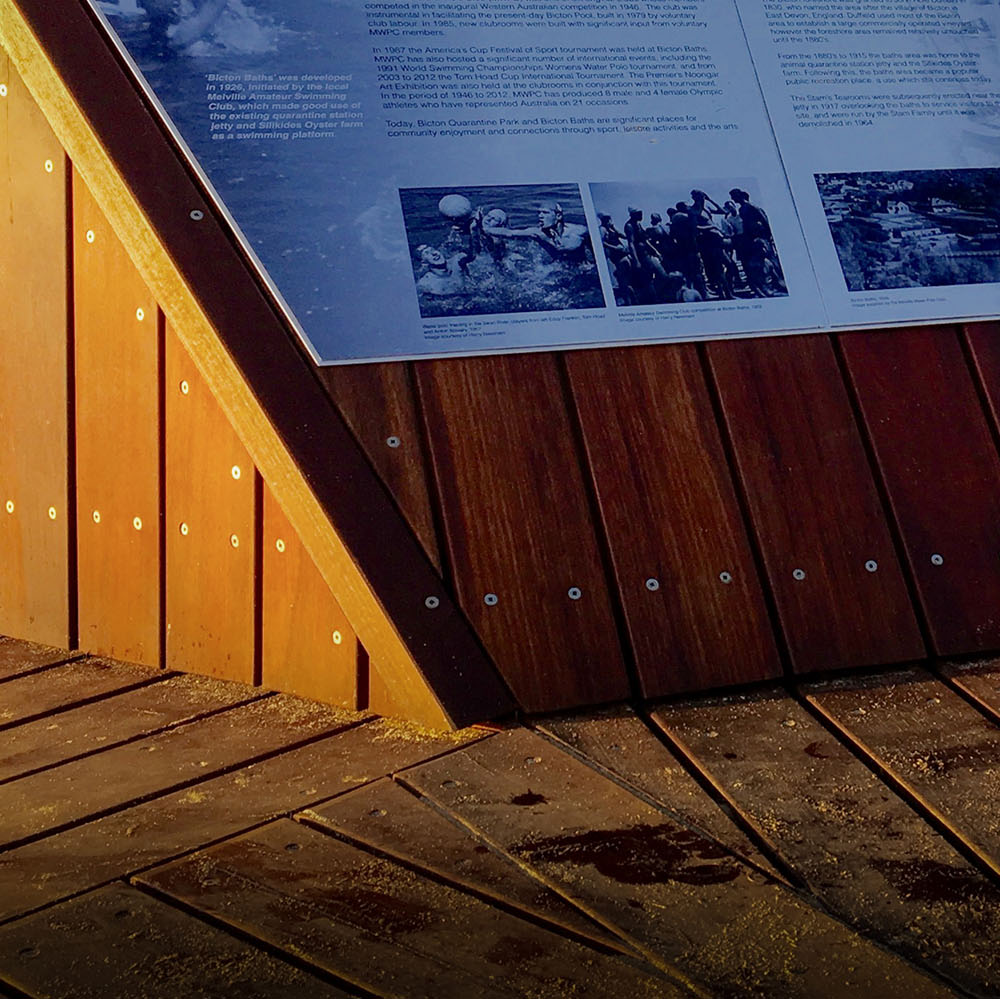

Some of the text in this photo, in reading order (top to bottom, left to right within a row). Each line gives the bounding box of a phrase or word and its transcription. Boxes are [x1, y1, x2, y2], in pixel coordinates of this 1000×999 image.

[300, 74, 353, 83] developed
[206, 83, 215, 91] in
[290, 83, 304, 92] by
[207, 92, 347, 101] Melville Amateur Swimming
[208, 102, 235, 112] Club,
[237, 102, 268, 110] which
[301, 101, 328, 111] good
[209, 112, 226, 120] the
[228, 112, 269, 121] existing
[271, 111, 326, 121] quarantine
[235, 121, 256, 129] and
[303, 120, 337, 130] Oyster
[340, 120, 364, 128] farm
[235, 130, 289, 141] swimming
